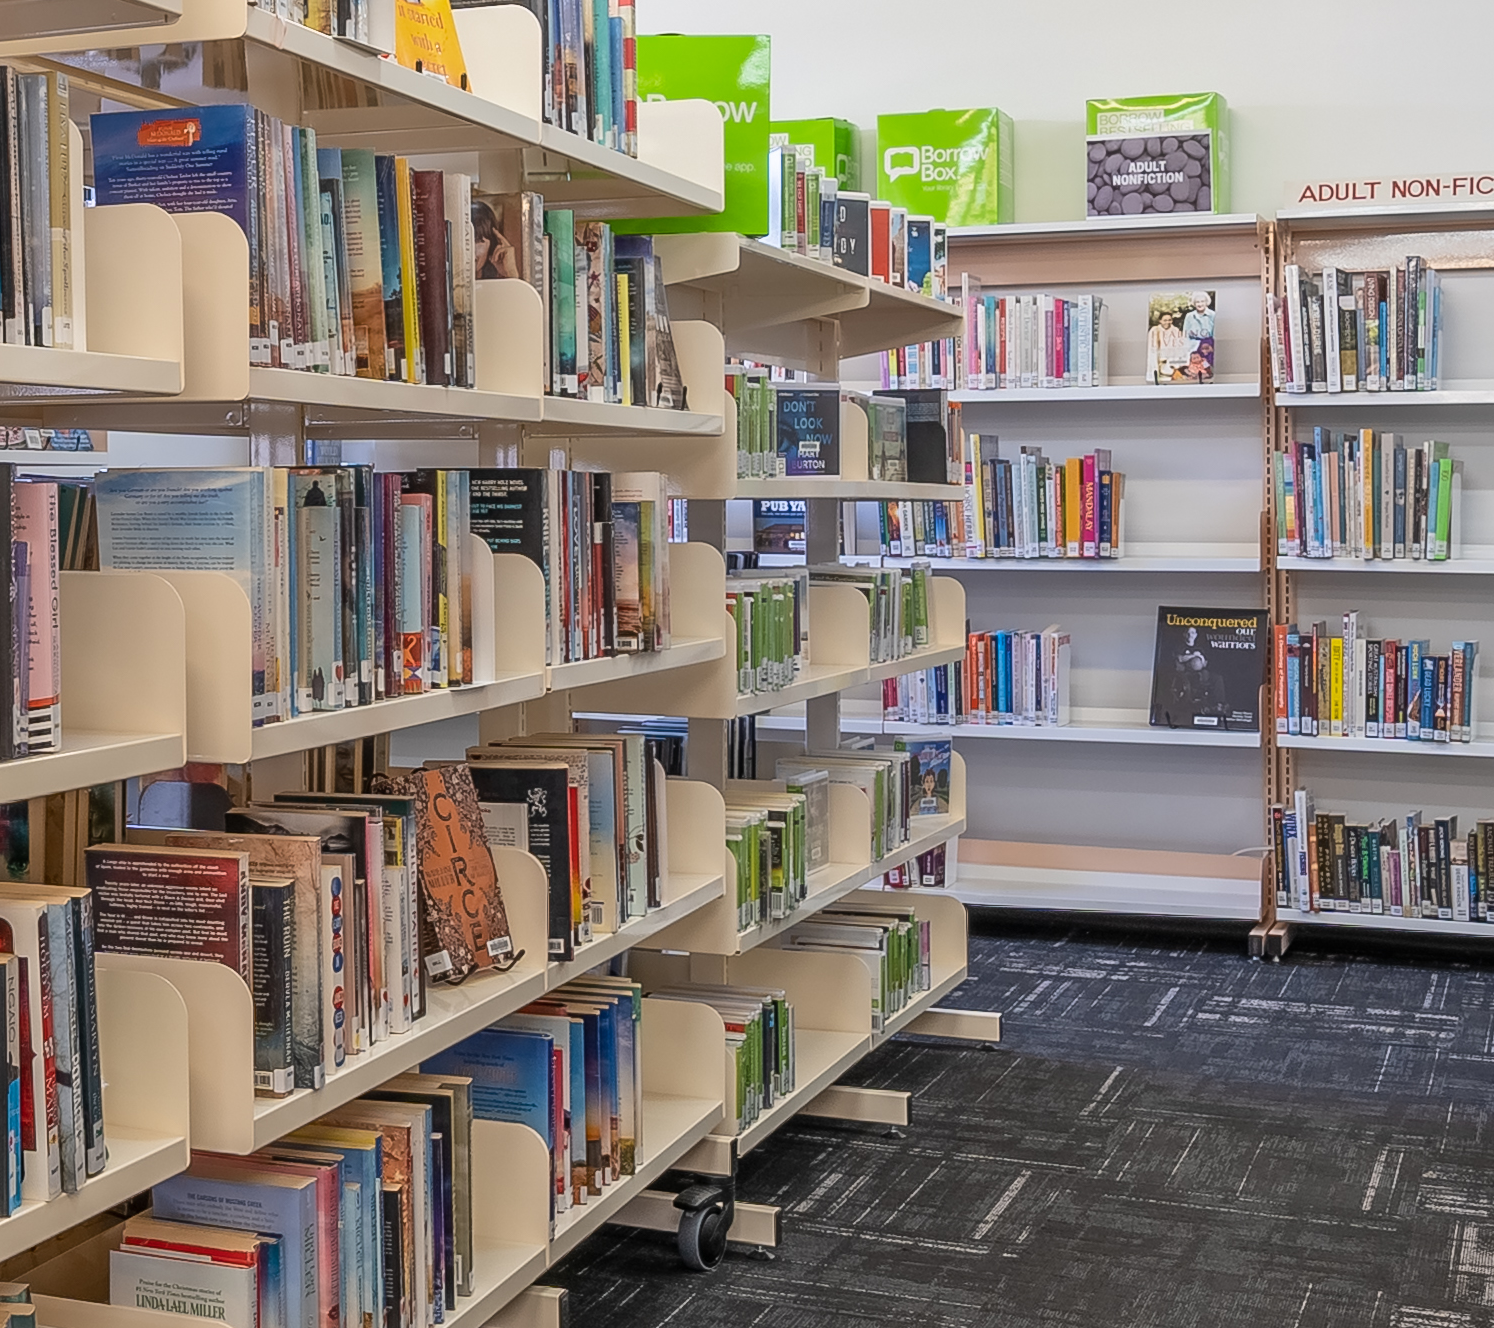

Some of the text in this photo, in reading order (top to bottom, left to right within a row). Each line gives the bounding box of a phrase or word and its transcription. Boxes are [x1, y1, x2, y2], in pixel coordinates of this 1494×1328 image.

[921, 144, 989, 165] Borrow
[921, 162, 960, 182] Box.
[1128, 160, 1167, 175] ADULT
[1112, 171, 1184, 185] NONFICTION
[1299, 182, 1381, 203] ADULT
[795, 418, 823, 429] LOOK
[434, 792, 487, 953] CIRCE
